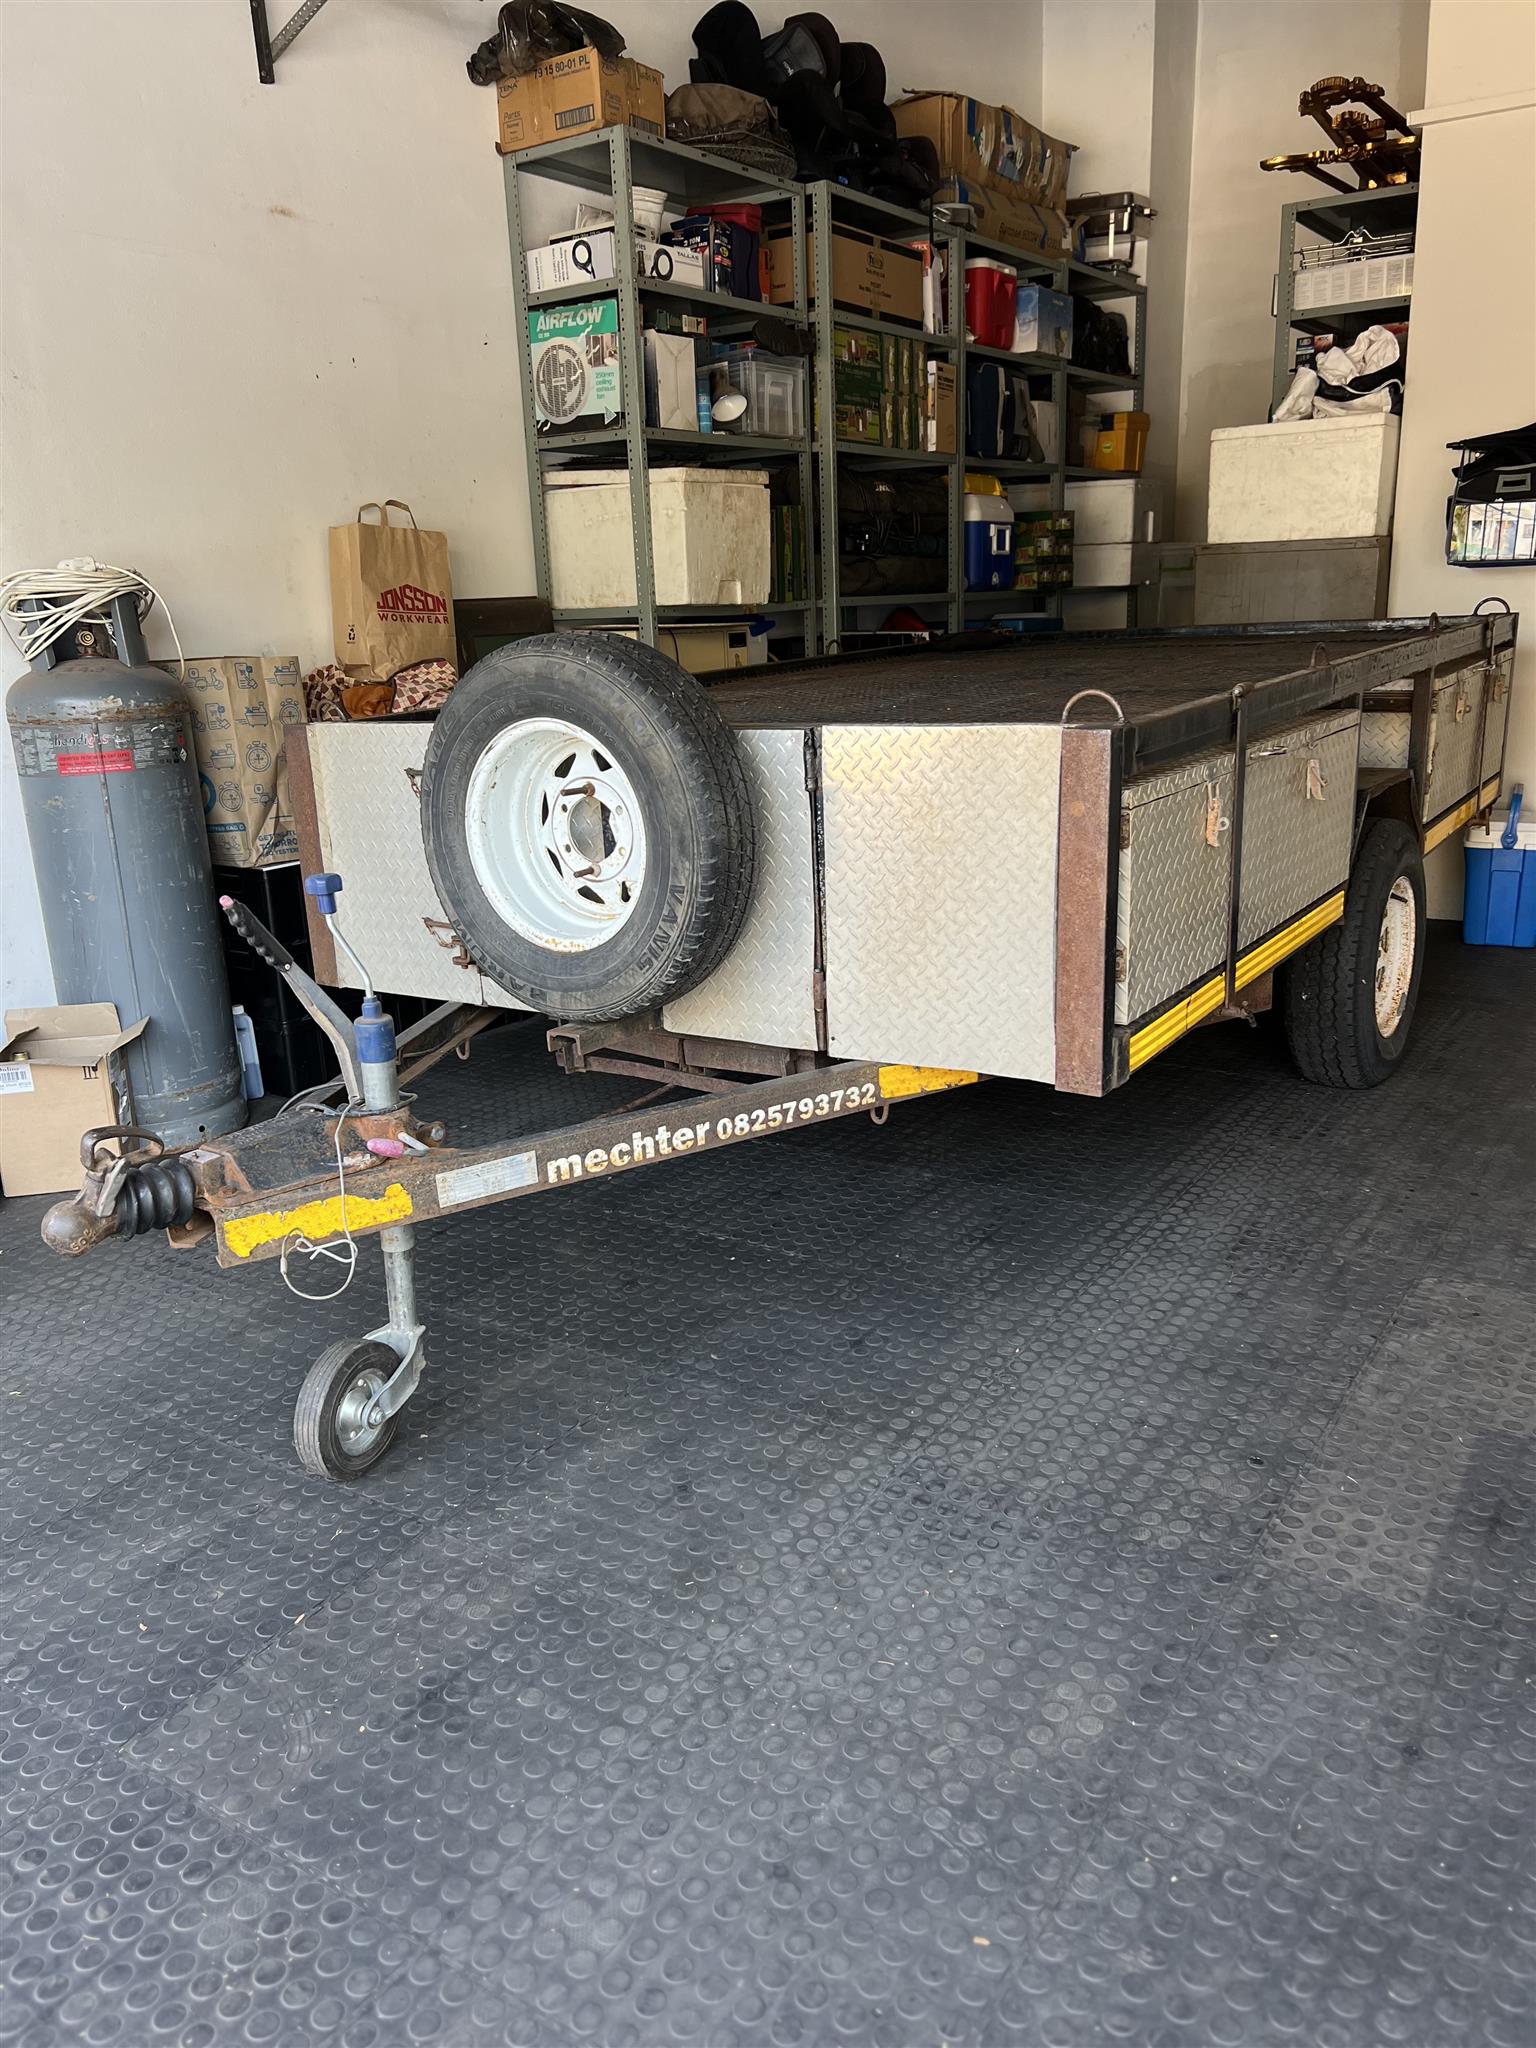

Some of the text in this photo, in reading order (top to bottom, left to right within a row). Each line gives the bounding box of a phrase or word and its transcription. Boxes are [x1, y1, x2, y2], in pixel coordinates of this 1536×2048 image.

[544, 64, 554, 76] 15
[578, 53, 590, 66] PL
[536, 305, 604, 333] AIRFLOW
[376, 583, 448, 613] JONSSON
[377, 612, 450, 625] WORKWEAR
[547, 1121, 710, 1184] mechter
[716, 1082, 876, 1141] 0825793732
